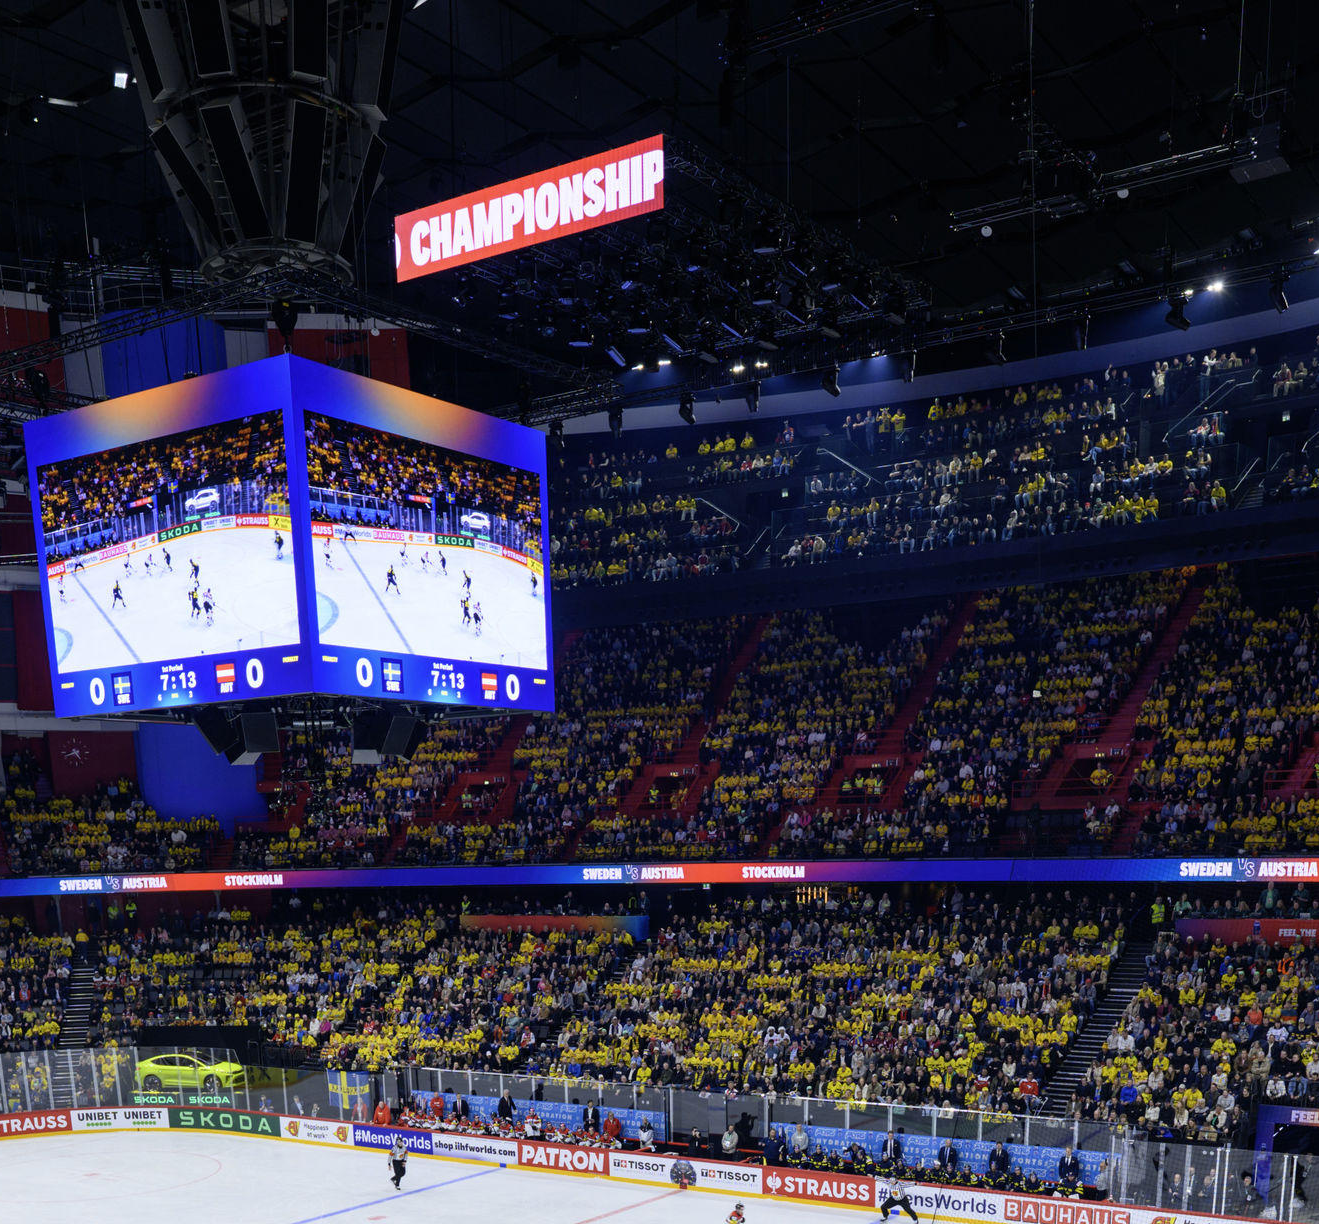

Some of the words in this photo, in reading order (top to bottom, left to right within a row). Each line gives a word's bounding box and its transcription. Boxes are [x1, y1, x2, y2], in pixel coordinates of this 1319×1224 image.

[410, 149, 665, 267] CHAMPIONSHIP
[242, 516, 269, 526] STRAUSS
[373, 529, 405, 542] BAUHAUS
[245, 658, 265, 689] 0
[356, 657, 374, 688] 0
[431, 670, 465, 689] 7:13
[160, 671, 197, 691] 7:13
[220, 682, 234, 694] AUT
[386, 680, 401, 692] SWE
[505, 674, 520, 701] 0
[89, 677, 106, 706] 0
[117, 693, 131, 705] SWE
[188, 690, 194, 698] 3
[582, 868, 623, 880] SWEDEN
[624, 864, 639, 880] VS
[641, 867, 685, 880] AUSTRIA
[741, 865, 806, 879] STOCKHOLM
[1179, 861, 1233, 877] SWEDEN
[1237, 858, 1256, 877] VS
[1258, 860, 1319, 877] AUSTRIA
[59, 880, 102, 891] SWEDEN
[104, 875, 120, 890] VS
[122, 877, 168, 889] AUSTRIA
[224, 874, 283, 887] STOCKHOLM
[1278, 928, 1298, 937] FEEL
[1300, 928, 1318, 938] THE
[77, 1111, 118, 1122] UNIBET
[124, 1110, 163, 1120] UNIBET
[522, 1144, 605, 1172] PATRON
[628, 1160, 666, 1173] TISSOT
[716, 1170, 758, 1183] TISSOT
[784, 1175, 870, 1201] STRAUSS
[878, 1188, 997, 1215] #ensWorlds
